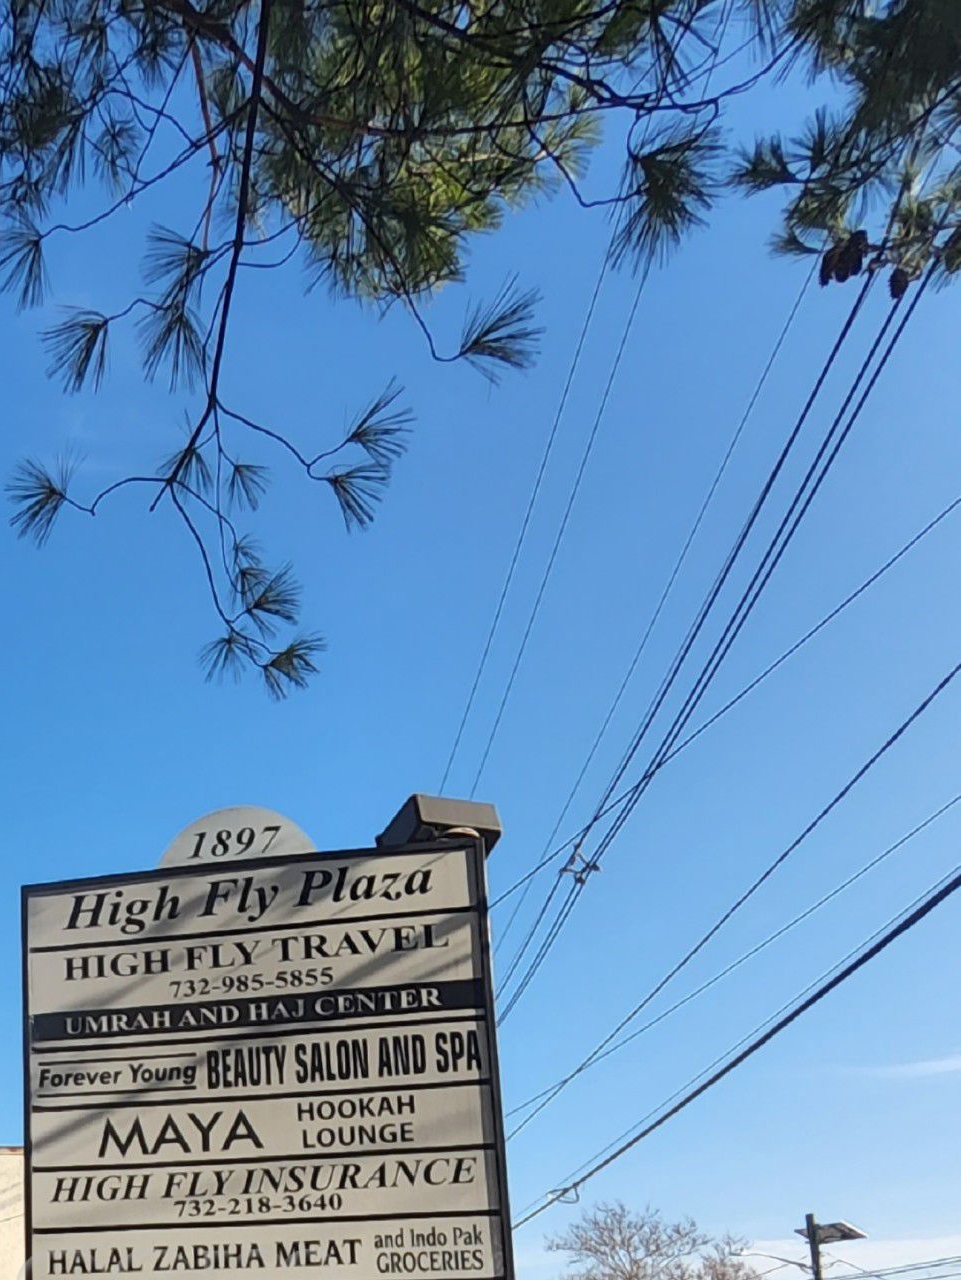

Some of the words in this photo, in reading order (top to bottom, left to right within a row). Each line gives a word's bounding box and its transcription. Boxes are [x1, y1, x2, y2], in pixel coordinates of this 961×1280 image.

[187, 824, 282, 860] 1897
[64, 885, 180, 934] High
[199, 877, 279, 922] Fly
[296, 864, 433, 907] Plaza
[64, 948, 170, 982] HIGH
[183, 940, 261, 971] FLY
[272, 922, 449, 963] TRAVEL
[168, 966, 334, 1000] 732-985-5855
[64, 1009, 171, 1036] UMRAH
[179, 1004, 239, 1028] AND
[248, 998, 306, 1023] HAJ
[314, 987, 442, 1016] CENTER
[39, 1067, 122, 1089] Forever
[128, 1062, 197, 1088] Young
[207, 1044, 286, 1090] BEAUTY
[295, 1038, 369, 1085] SALON
[378, 1034, 426, 1077] AND
[435, 1029, 481, 1072] SPA
[296, 1094, 416, 1122] HOOKAH
[98, 1109, 264, 1159] MAYA
[301, 1121, 415, 1150] LOUNGE
[50, 1172, 153, 1203] HIGH
[163, 1168, 236, 1198] FLY
[239, 1156, 477, 1196] INSURANCE
[173, 1192, 343, 1218] 732-218-3640
[374, 1229, 405, 1250] and
[410, 1227, 448, 1248] Indo
[452, 1223, 483, 1246] Pak
[48, 1247, 143, 1275] HALAL
[153, 1242, 265, 1272] ZABIHA
[275, 1237, 363, 1268] MEAT
[376, 1249, 484, 1275] GROCERIES
